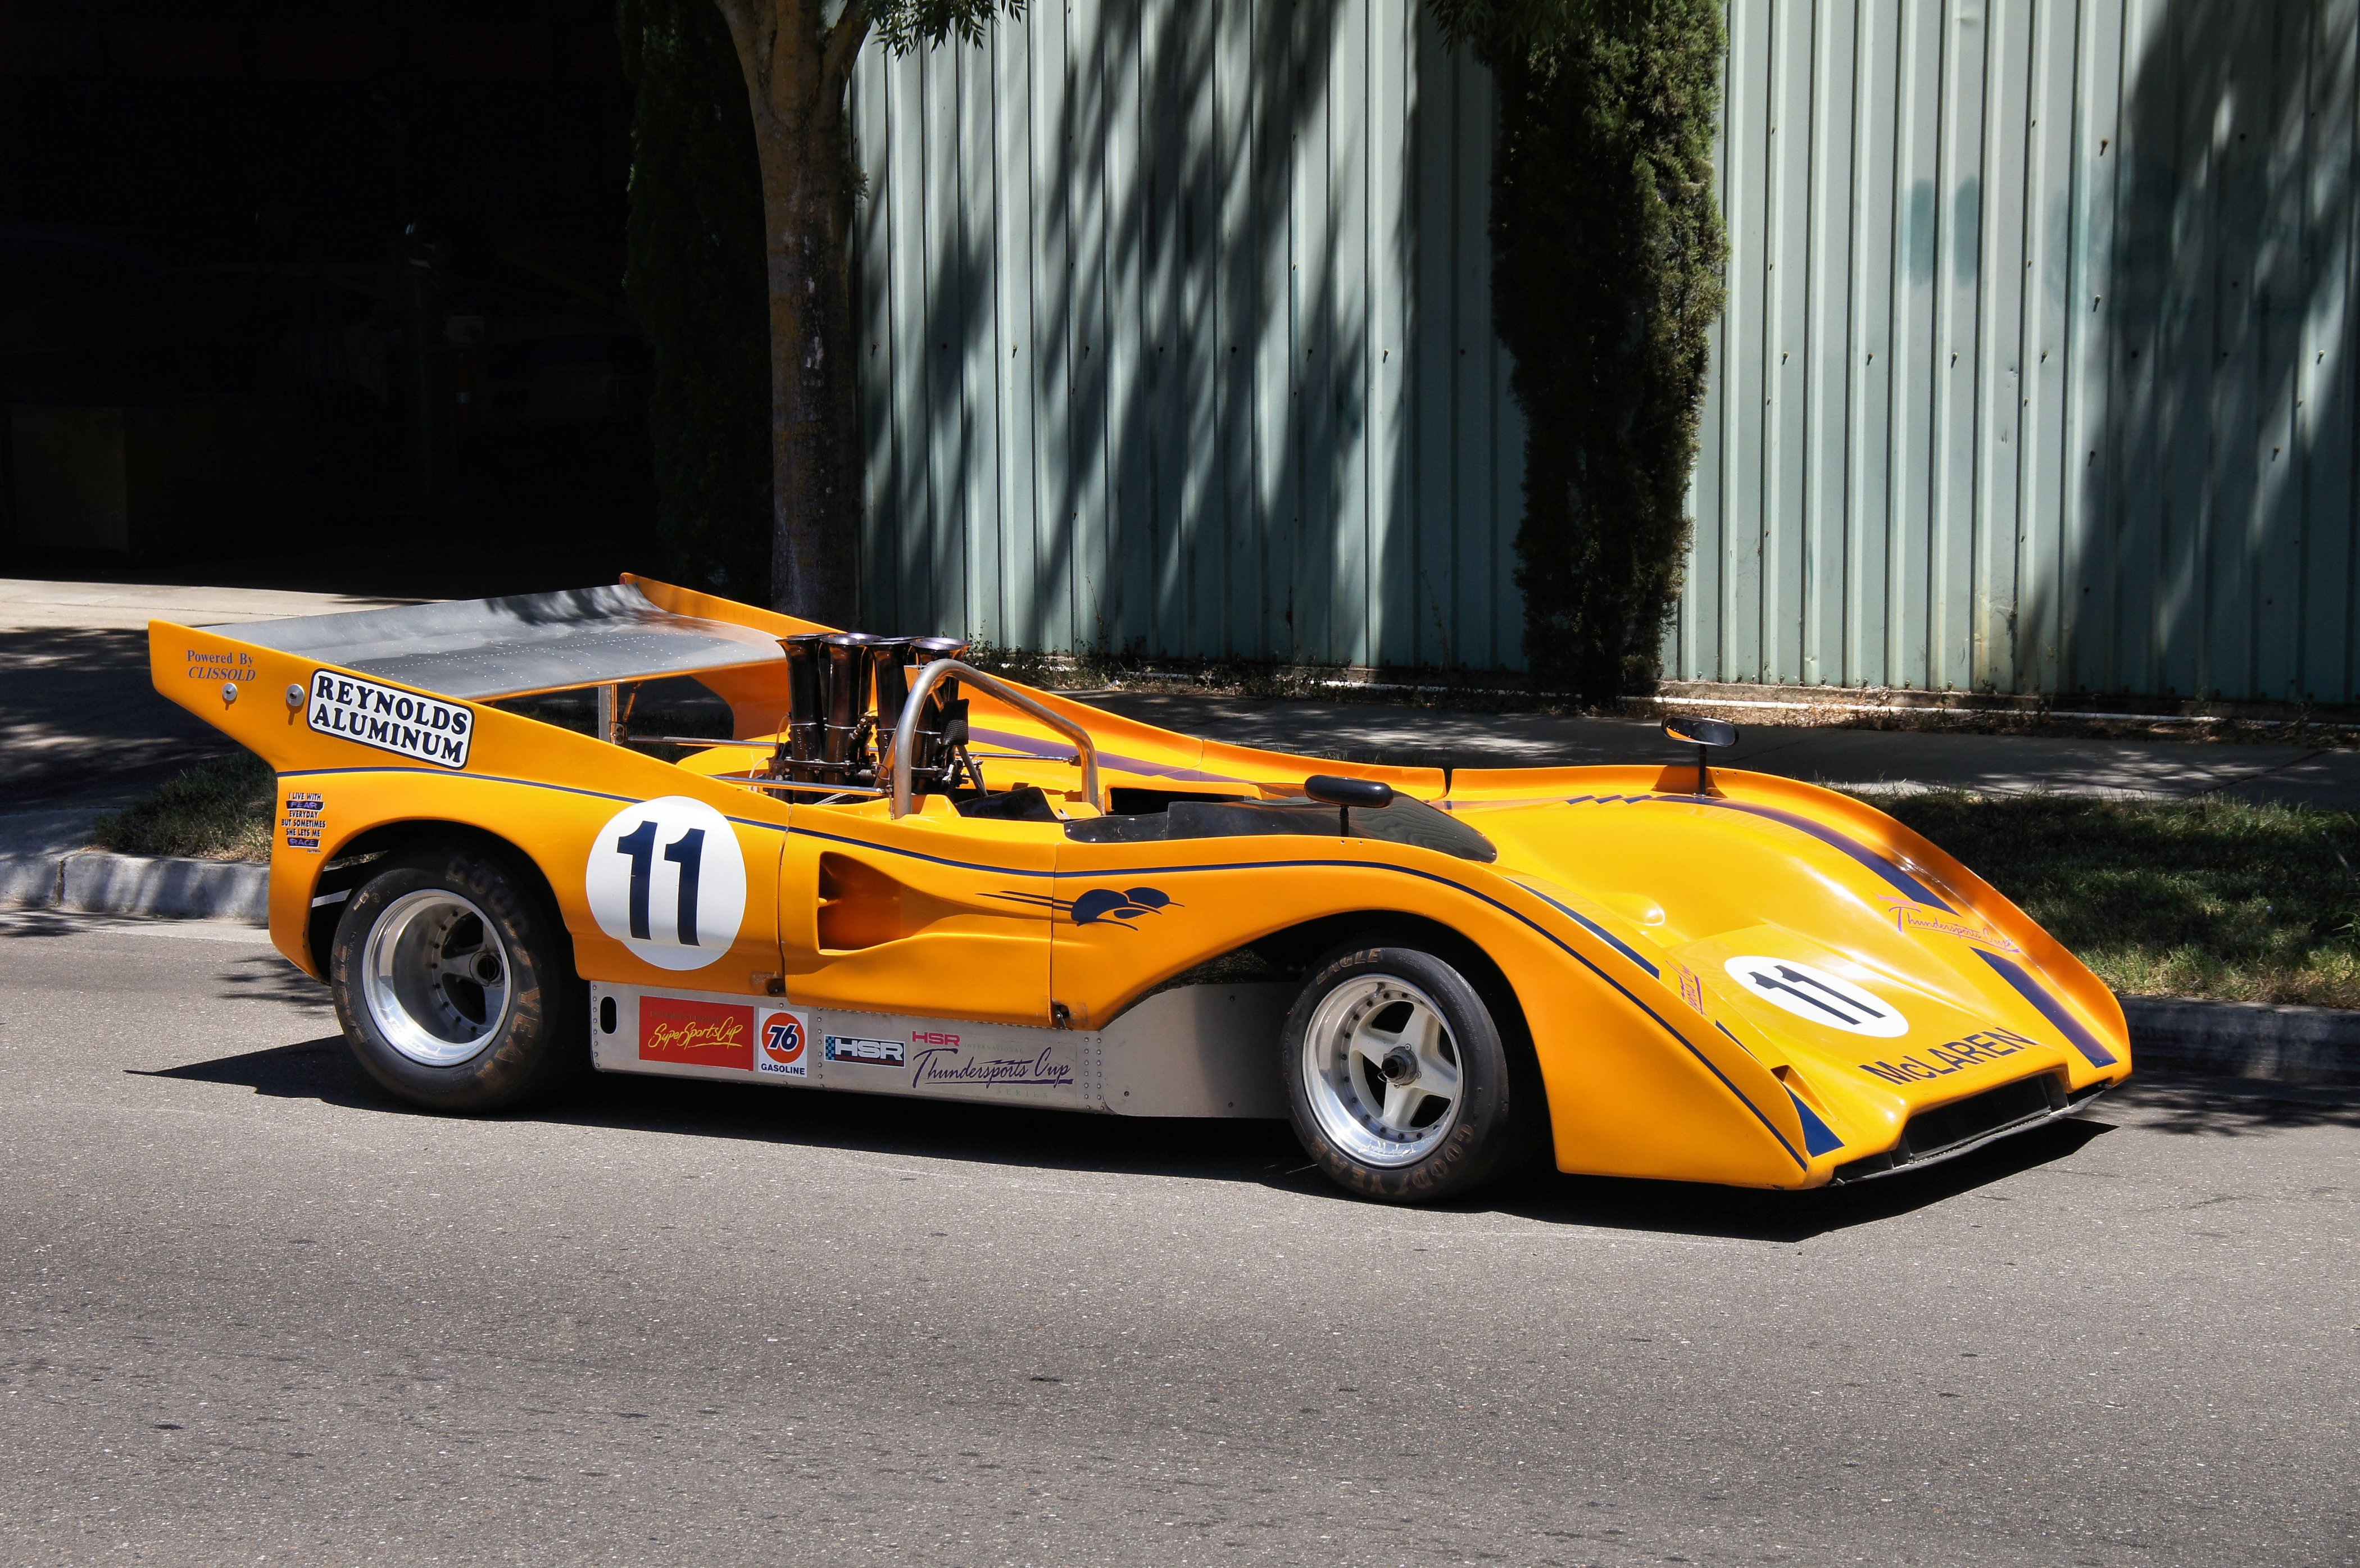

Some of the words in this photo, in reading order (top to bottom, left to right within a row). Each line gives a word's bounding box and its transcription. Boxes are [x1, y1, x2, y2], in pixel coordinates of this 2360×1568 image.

[187, 650, 233, 663] Powered
[239, 652, 253, 667] By
[188, 666, 256, 681] CLISSOLD
[316, 675, 468, 735] REYNOLDS
[312, 703, 464, 763] ALUMINUM
[616, 820, 705, 947] 11
[1316, 948, 1382, 986] EAGLE
[1748, 964, 1886, 1025] 11
[767, 1023, 798, 1052] 76
[835, 1038, 903, 1061] HSR
[912, 1031, 960, 1046] HSR
[964, 1042, 1024, 1054] INTERNATIONAL
[761, 1063, 805, 1075] GASOLINE
[913, 1048, 1029, 1088] Thundersports
[1034, 1047, 1071, 1088] Cup
[1858, 1027, 2039, 1085] McLAREN
[997, 1088, 1049, 1098] SERIES
